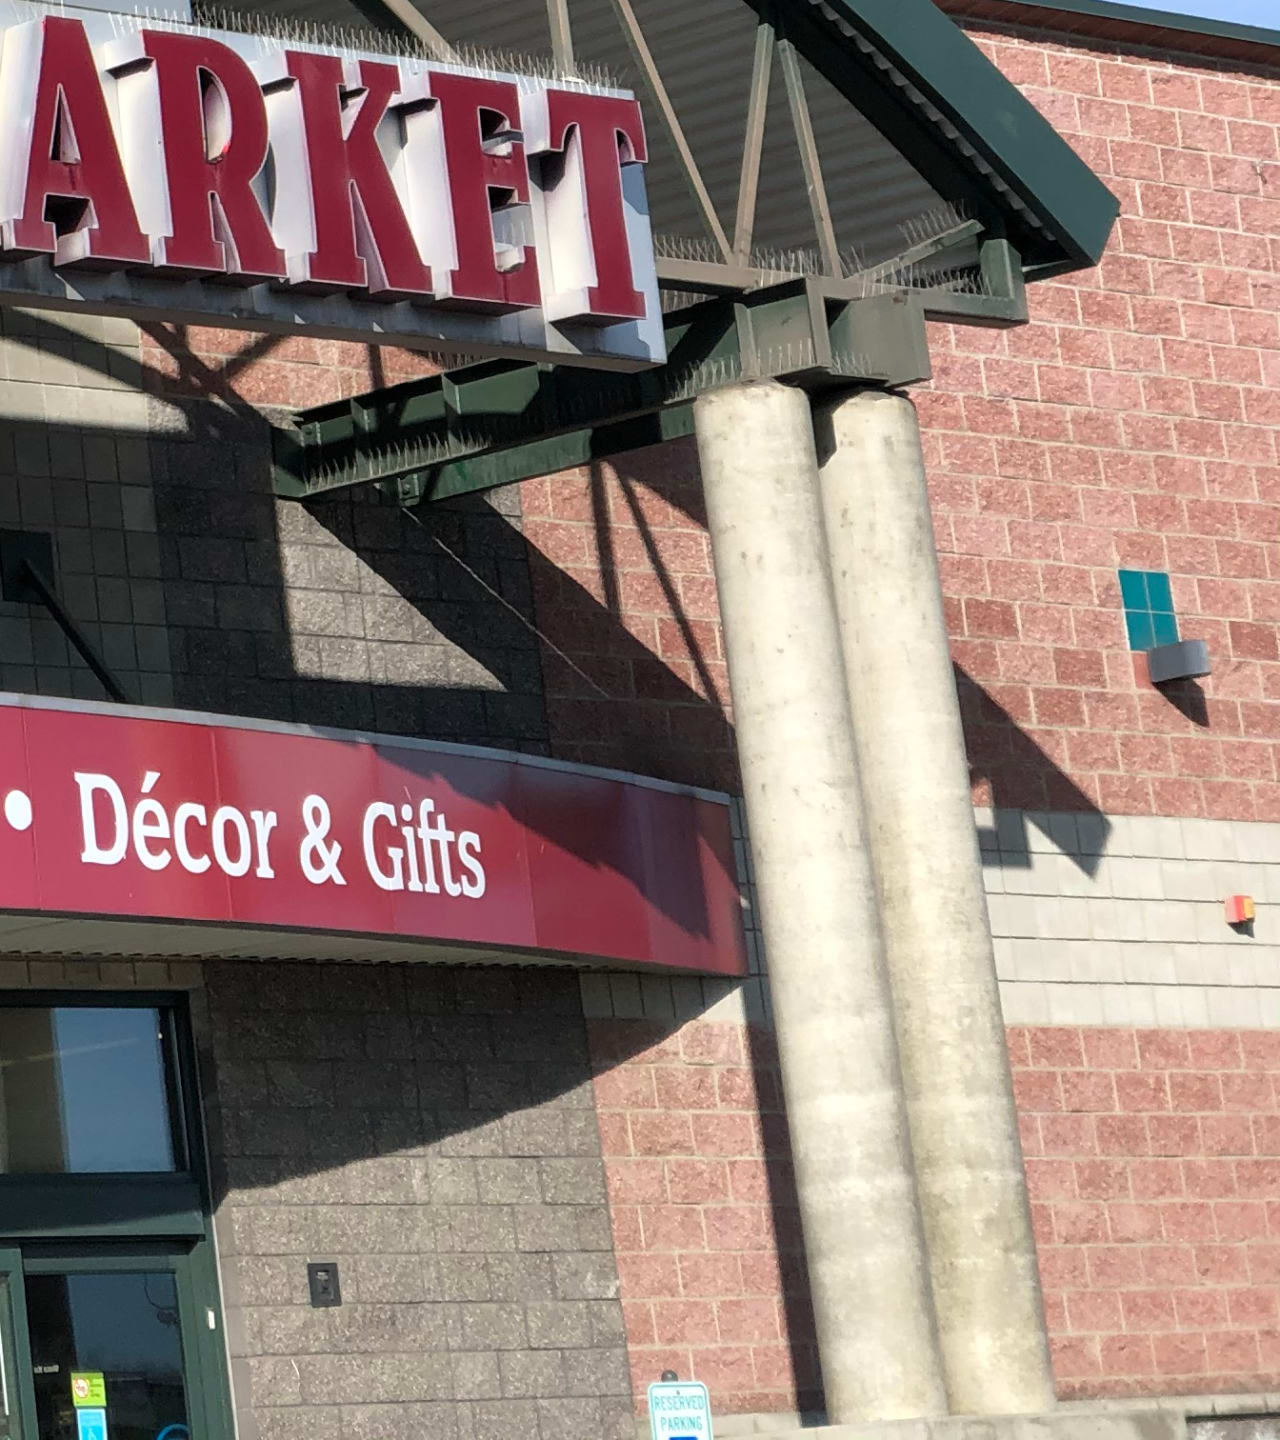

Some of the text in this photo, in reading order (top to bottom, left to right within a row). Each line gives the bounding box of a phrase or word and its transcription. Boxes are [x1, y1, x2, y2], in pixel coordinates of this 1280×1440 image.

[74, 771, 278, 880] Décor
[300, 794, 347, 886] &
[363, 798, 487, 899] Gifts
[653, 1395, 705, 1411] RESERVED
[660, 1415, 703, 1431] PARKING
